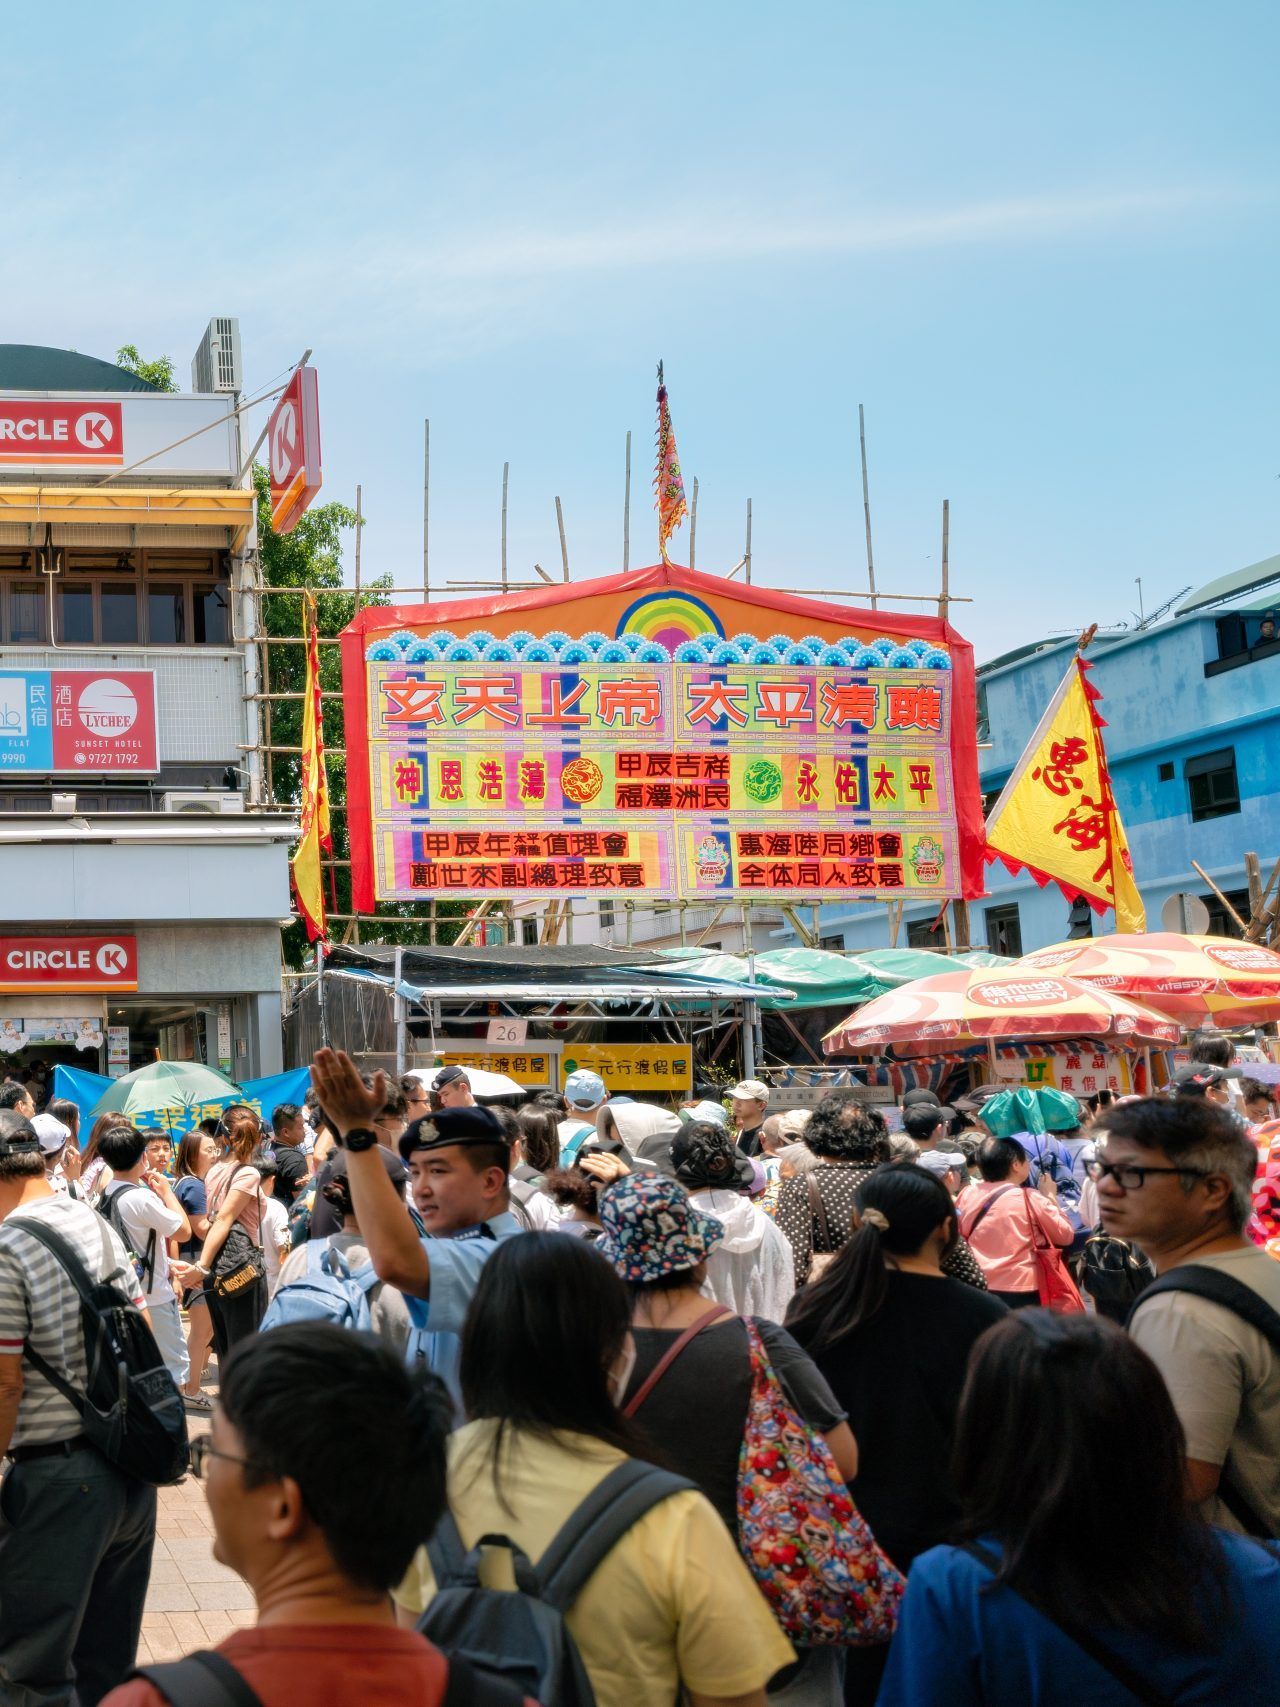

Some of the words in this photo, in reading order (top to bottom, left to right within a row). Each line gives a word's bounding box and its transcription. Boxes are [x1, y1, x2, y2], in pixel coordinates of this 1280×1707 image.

[80, 414, 113, 446] K
[31, 685, 47, 727] 民宿
[55, 685, 72, 727] 酒店
[379, 677, 662, 726] 玄天上帝
[686, 680, 942, 731] 太平清醮
[86, 714, 132, 728] LYCHEE
[75, 740, 109, 748] SUNSET
[114, 740, 142, 748] HOTEL
[1, 753, 26, 764] 9990
[88, 753, 113, 764] 9727
[115, 753, 139, 764] 1792
[618, 753, 730, 779] 甲辰吉祥
[394, 759, 545, 801] 神恩浩蕩
[796, 761, 934, 804] 永佑太平
[616, 784, 729, 808] 福澤洲民
[738, 832, 903, 858] 惠海陸同鄉會
[7, 950, 90, 969] CIRCLE
[100, 945, 127, 972] K
[495, 1025, 517, 1041] 26
[1066, 1054, 1106, 1069] 麗晶
[222, 1264, 257, 1292] MOSCHINO
